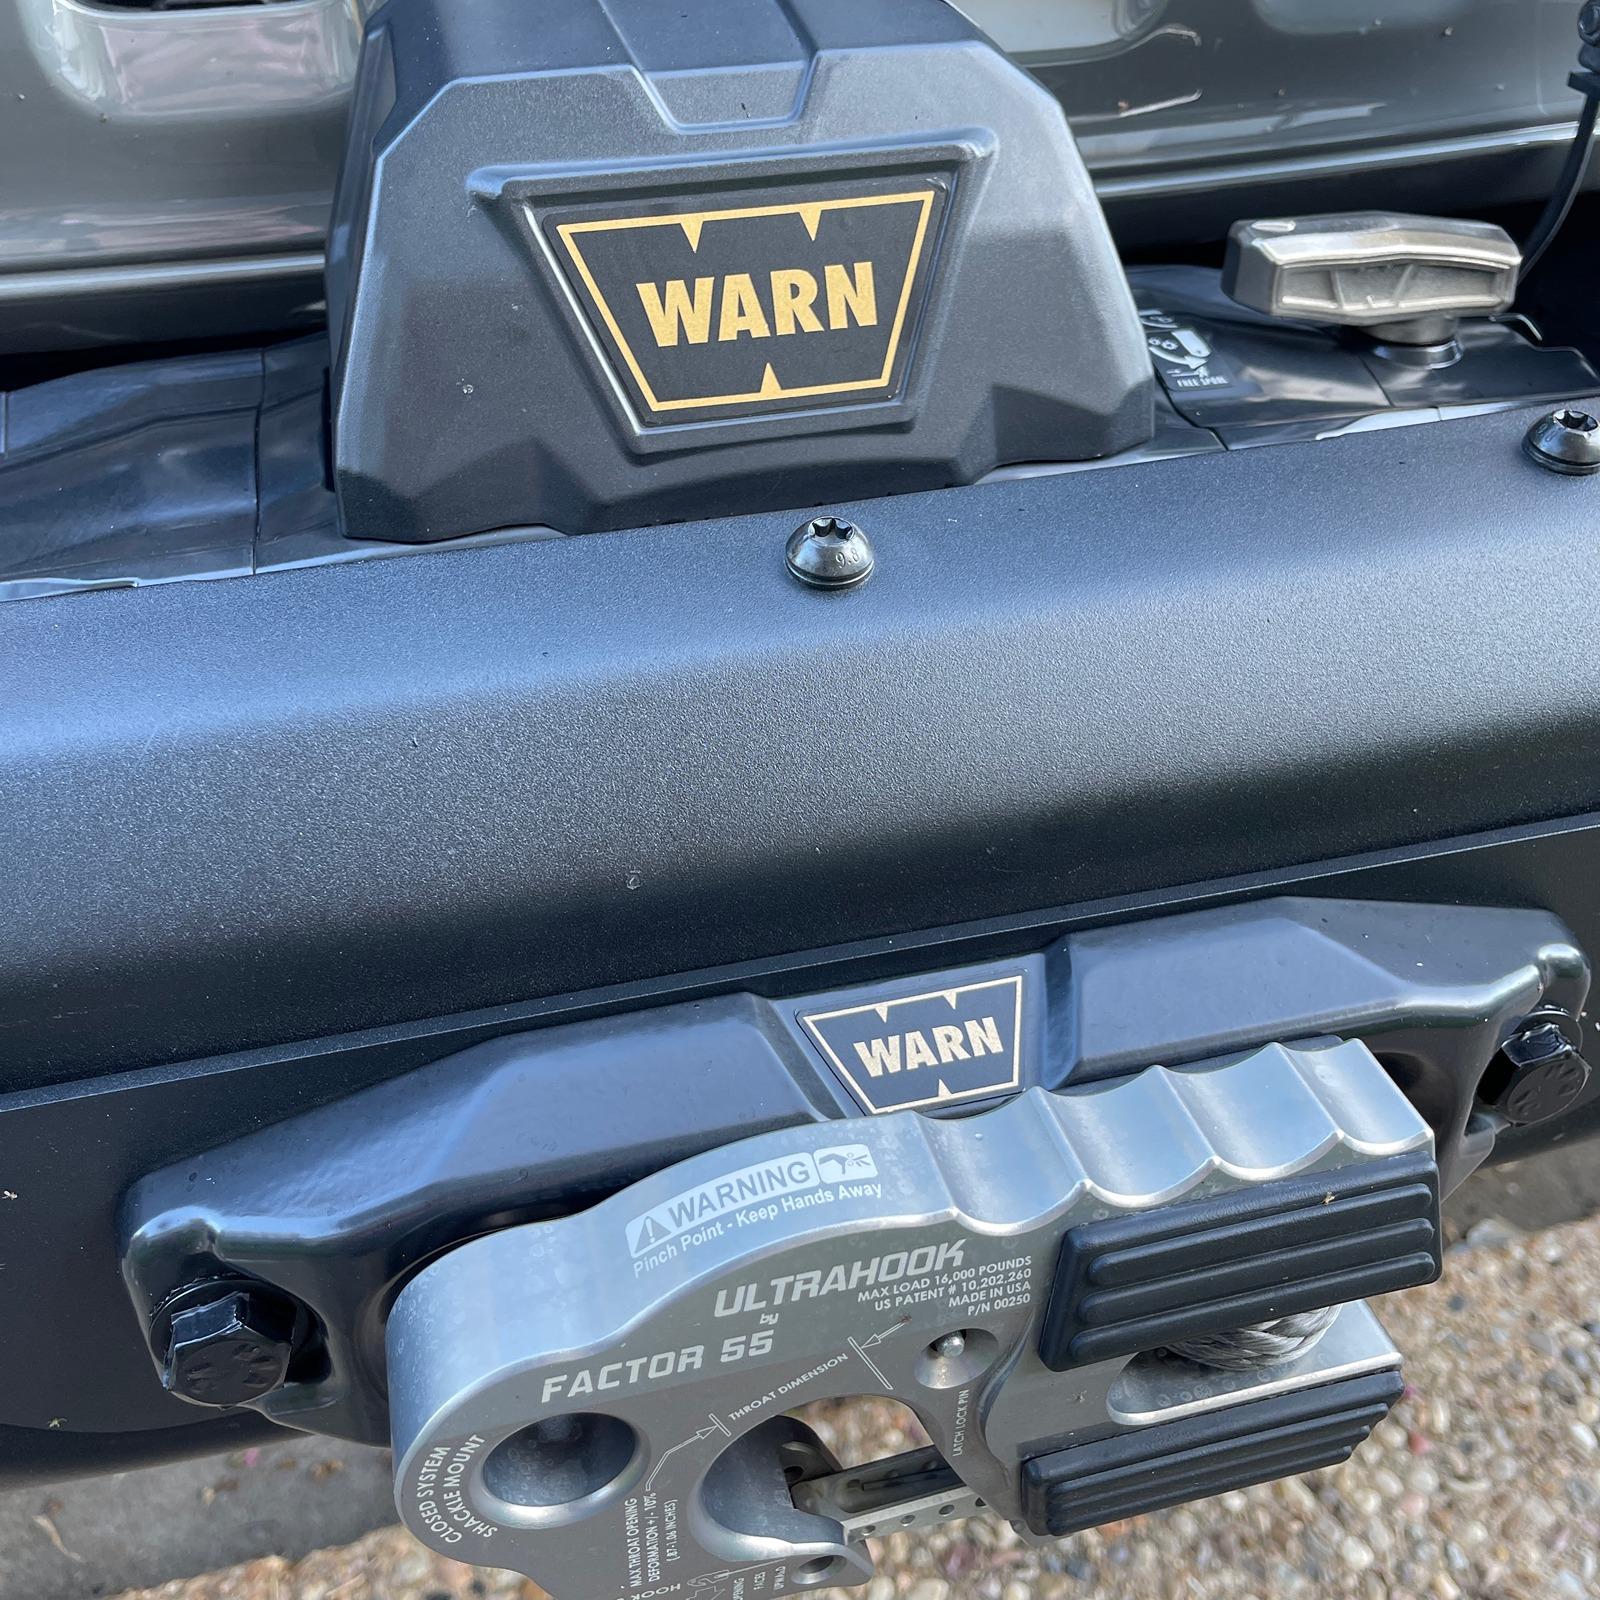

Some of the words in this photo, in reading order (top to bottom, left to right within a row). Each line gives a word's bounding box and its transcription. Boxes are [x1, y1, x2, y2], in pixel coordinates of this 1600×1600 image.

[635, 261, 878, 347] WARN
[853, 1016, 1004, 1078] WARN
[667, 1160, 811, 1229] WARNING
[633, 1242, 678, 1279] Pinch
[680, 1221, 724, 1252] Point
[735, 1202, 779, 1228] Keep
[781, 1188, 834, 1213] Hands
[838, 1181, 882, 1199] Away
[714, 1238, 967, 1318] ULTRAHOOK
[857, 1286, 889, 1303] MAX
[893, 1278, 930, 1295] LOAD
[935, 1267, 976, 1285] 16,000
[979, 1255, 1032, 1276] POUNDS
[875, 1300, 891, 1311] US
[895, 1287, 945, 1307] PATENT
[948, 1285, 957, 1295] #
[948, 1291, 987, 1308] MADE
[990, 1287, 1003, 1298] IN
[1007, 1281, 1031, 1294] USA
[760, 1311, 779, 1326] by
[967, 1302, 990, 1316] P/N
[994, 1293, 1031, 1310] 00250
[541, 1345, 704, 1403] FACTOR
[720, 1328, 775, 1363] 55
[728, 1391, 777, 1421] THROAT
[779, 1352, 848, 1395] DIMENSION
[955, 1405, 968, 1429] LOCK
[958, 1389, 970, 1405] PIN
[443, 1434, 485, 1487] MOUNT
[952, 1430, 965, 1457] LATCH
[416, 1446, 451, 1498] SYSTEM
[418, 1500, 463, 1543] CLOSED
[443, 1490, 498, 1538] SHACKLE
[624, 1497, 639, 1536] OPENING
[643, 1492, 657, 1511] 10%
[664, 1499, 679, 1530] INCHES)
[627, 1537, 641, 1569] THROAT
[645, 1525, 660, 1582] DEFORMATION
[630, 1567, 642, 1588] MAX
